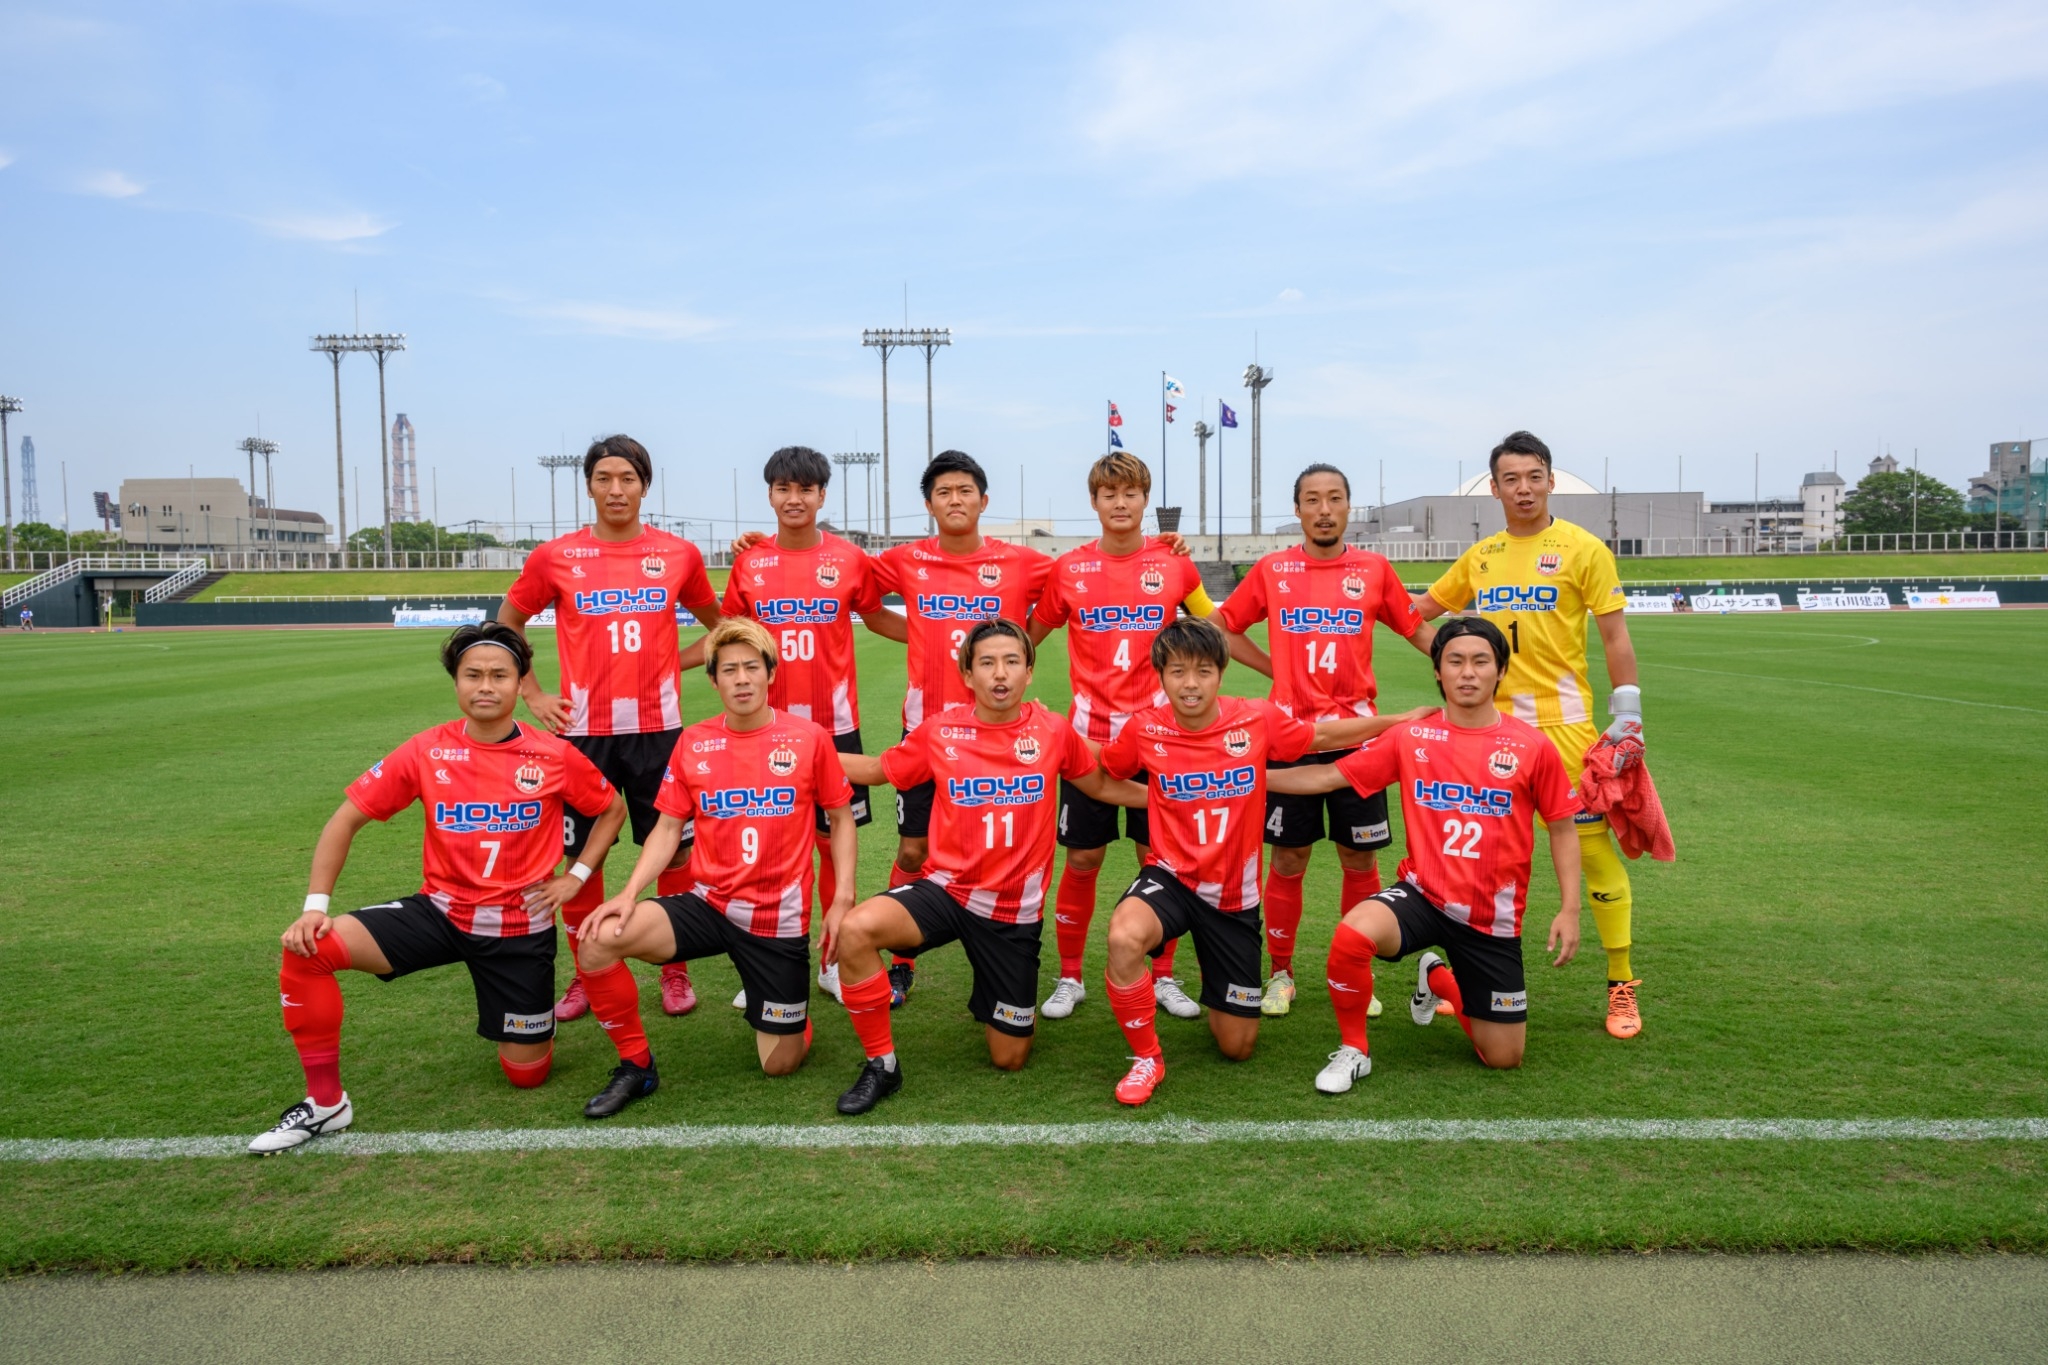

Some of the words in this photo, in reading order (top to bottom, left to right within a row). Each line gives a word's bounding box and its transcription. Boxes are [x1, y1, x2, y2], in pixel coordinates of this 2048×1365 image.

[575, 587, 668, 610] HOYO
[755, 598, 840, 618] HOYO
[917, 594, 1002, 612] HOYO
[1478, 585, 1558, 609] HOYO
[1510, 602, 1557, 612] GROUP
[1713, 597, 1778, 607] ムサシ工業
[1835, 596, 1886, 606] 石川建設
[619, 603, 667, 614] GROUP
[793, 614, 838, 624] GROUP
[955, 610, 1000, 621] GROUP
[1079, 605, 1164, 627] HOYO
[1280, 607, 1364, 628] HOYO
[607, 620, 641, 653] 18
[1119, 620, 1164, 632] GROUP
[1319, 624, 1363, 635] GROUP
[1508, 620, 1520, 654] 1
[781, 630, 814, 661] 50
[1113, 638, 1131, 671] 4
[1306, 641, 1337, 674] 14
[949, 774, 1044, 797] HOYO
[1159, 765, 1255, 793] HOYO
[700, 787, 796, 811] HOYO
[993, 793, 1044, 805] GROUP
[1205, 784, 1255, 799] GROUP
[1414, 779, 1512, 809] HOYO
[435, 800, 542, 823] HOYO
[745, 805, 794, 817] GROUP
[1459, 804, 1512, 817] GROUP
[486, 819, 540, 833] GROUP
[982, 811, 1013, 849] 11
[1193, 807, 1230, 845] 17
[741, 827, 759, 864] 9
[1442, 818, 1482, 860] 22
[480, 840, 501, 878] 7
